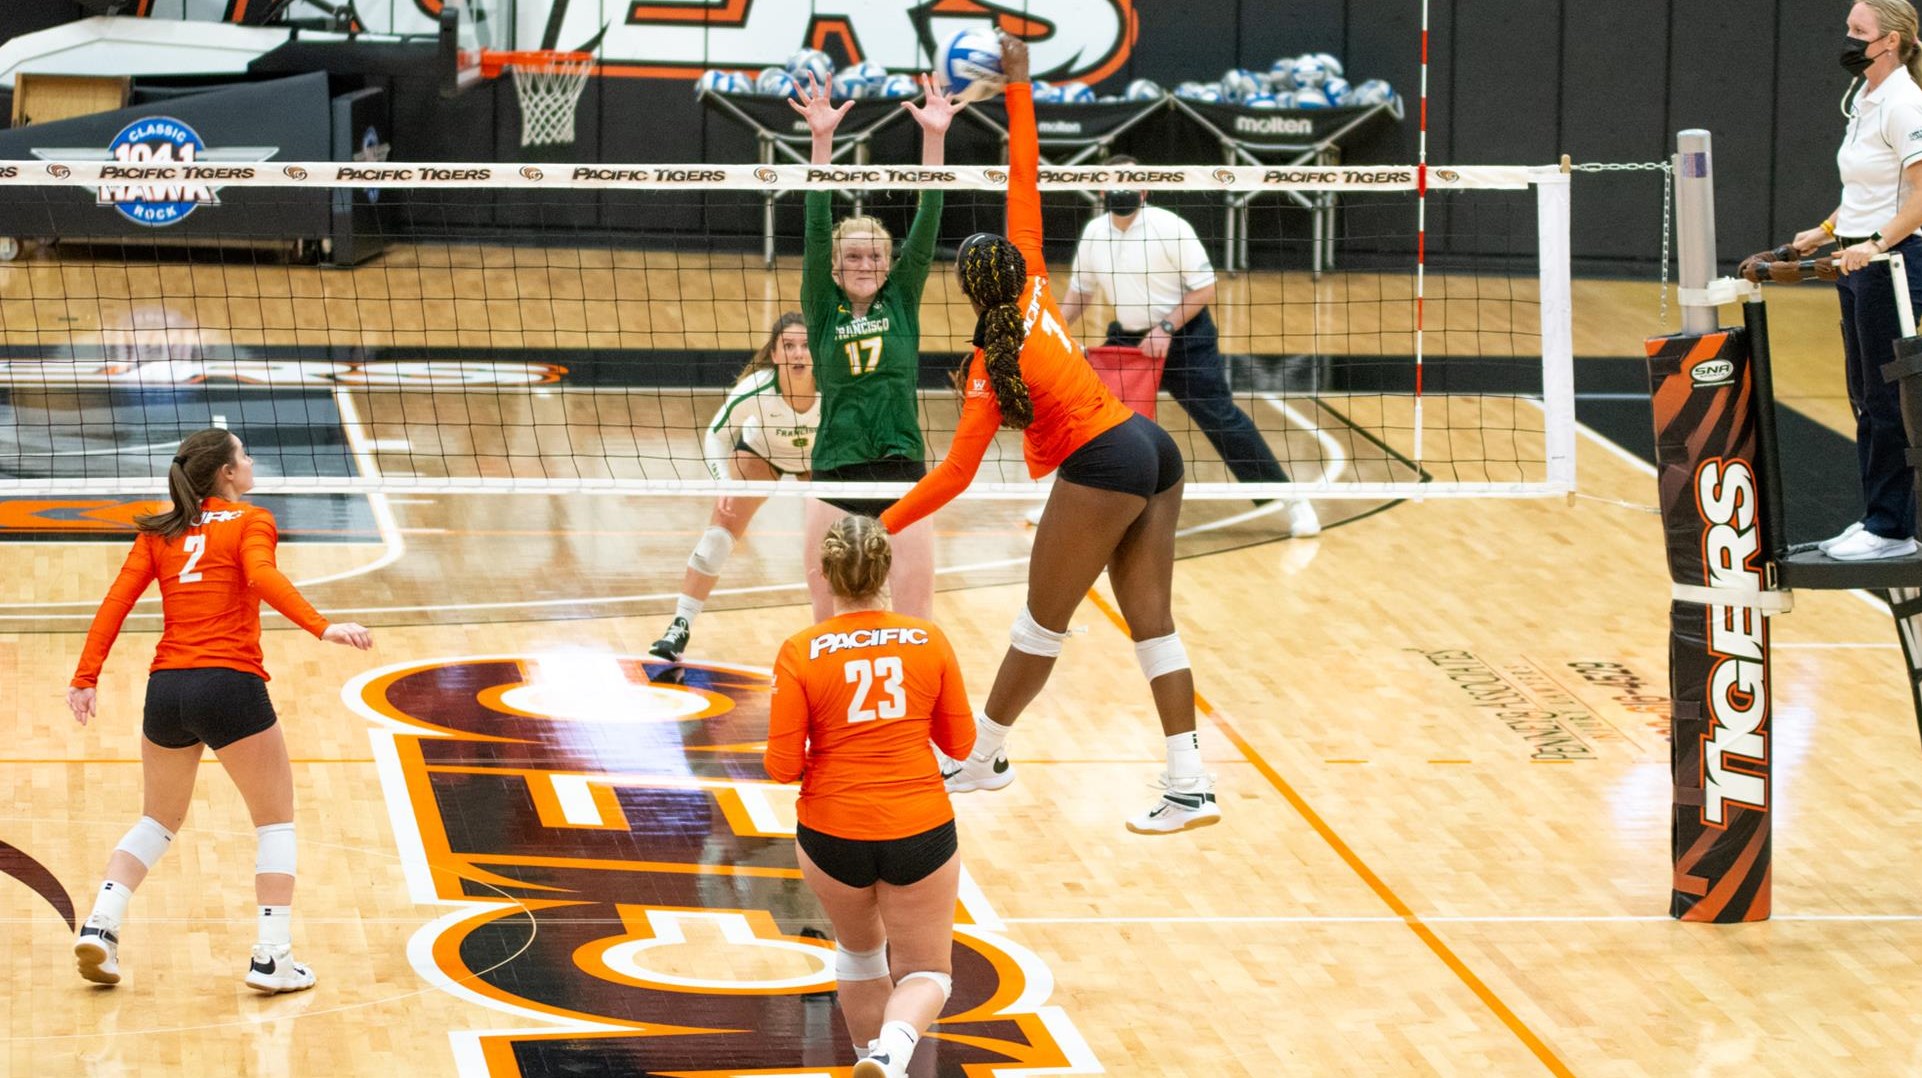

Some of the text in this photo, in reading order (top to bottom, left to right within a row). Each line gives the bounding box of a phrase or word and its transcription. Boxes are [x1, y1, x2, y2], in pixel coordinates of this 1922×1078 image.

[1236, 116, 1312, 134] molten
[129, 124, 187, 144] CLASSIC
[100, 165, 255, 179] PACIFIC TIGERS
[336, 167, 491, 180] PACIFIC TIGERS
[572, 167, 726, 182] PACIFIC TIGERS
[806, 169, 957, 182] PACIFIC TIGERS
[1038, 170, 1185, 183] PACIFIC TIGERS
[1263, 170, 1411, 183] PACIFIC TIGERS
[133, 204, 177, 220] ROCK
[844, 336, 883, 376] 17
[178, 533, 206, 584] 2
[810, 628, 928, 659] PACIFIC
[1697, 458, 1768, 826] TIGERS
[844, 656, 906, 723] 23
